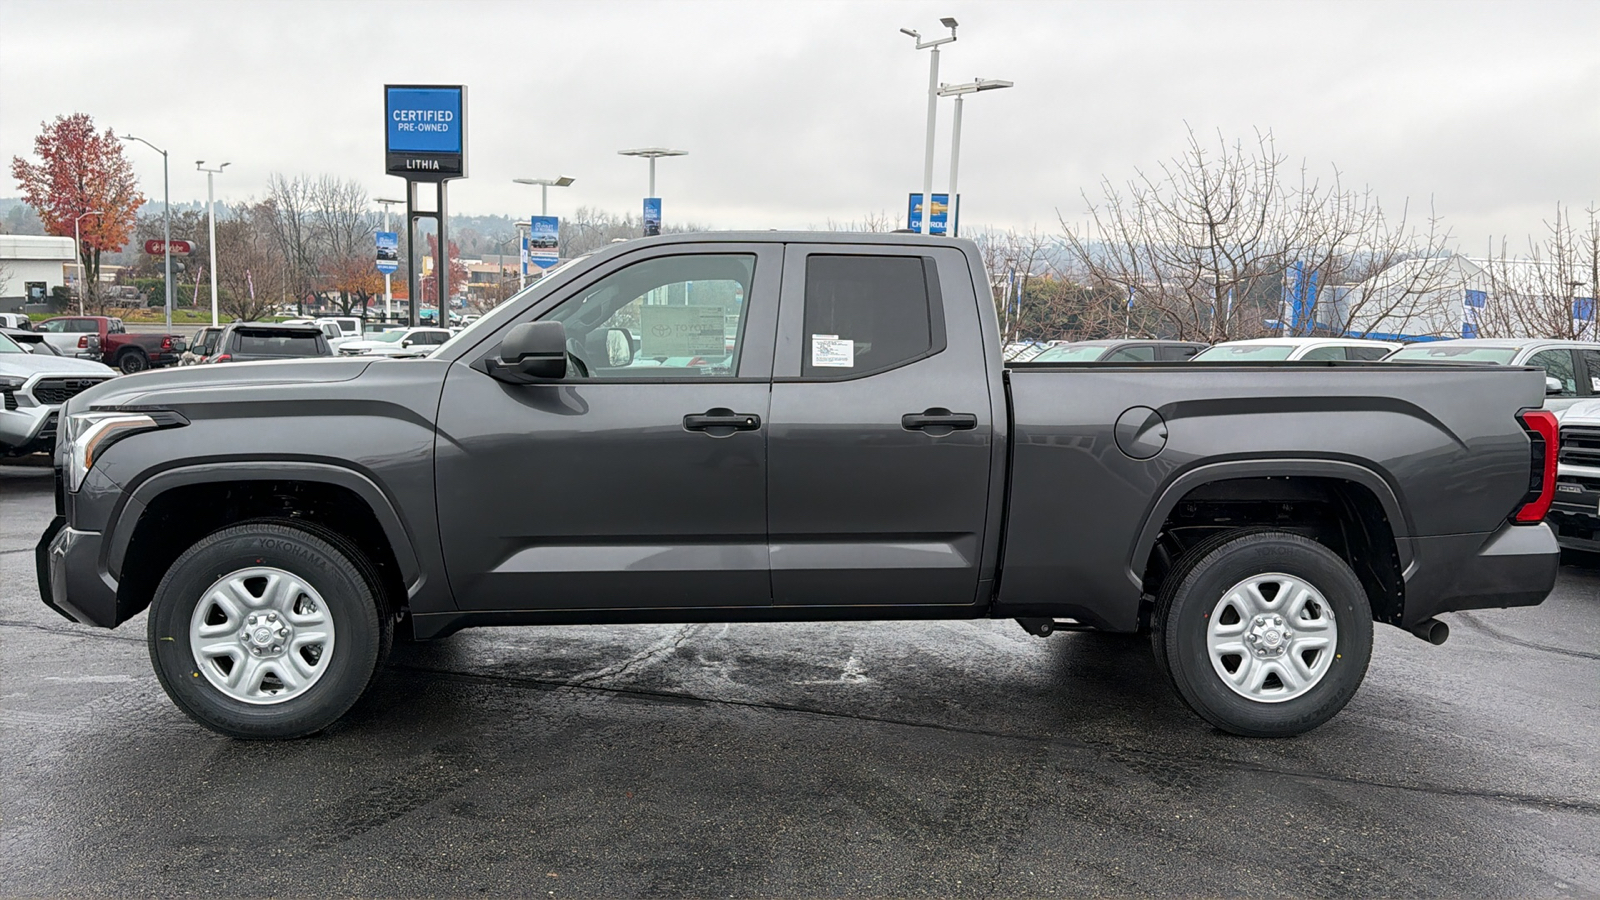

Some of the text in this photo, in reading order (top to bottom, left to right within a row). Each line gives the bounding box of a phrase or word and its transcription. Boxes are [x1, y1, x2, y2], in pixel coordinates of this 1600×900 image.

[393, 110, 453, 121] CERTIFIED
[398, 123, 448, 132] PRE-OWNED
[406, 159, 439, 170] LITHIA
[674, 323, 713, 332] TOYOTA
[259, 538, 327, 569] YOKOHAMA
